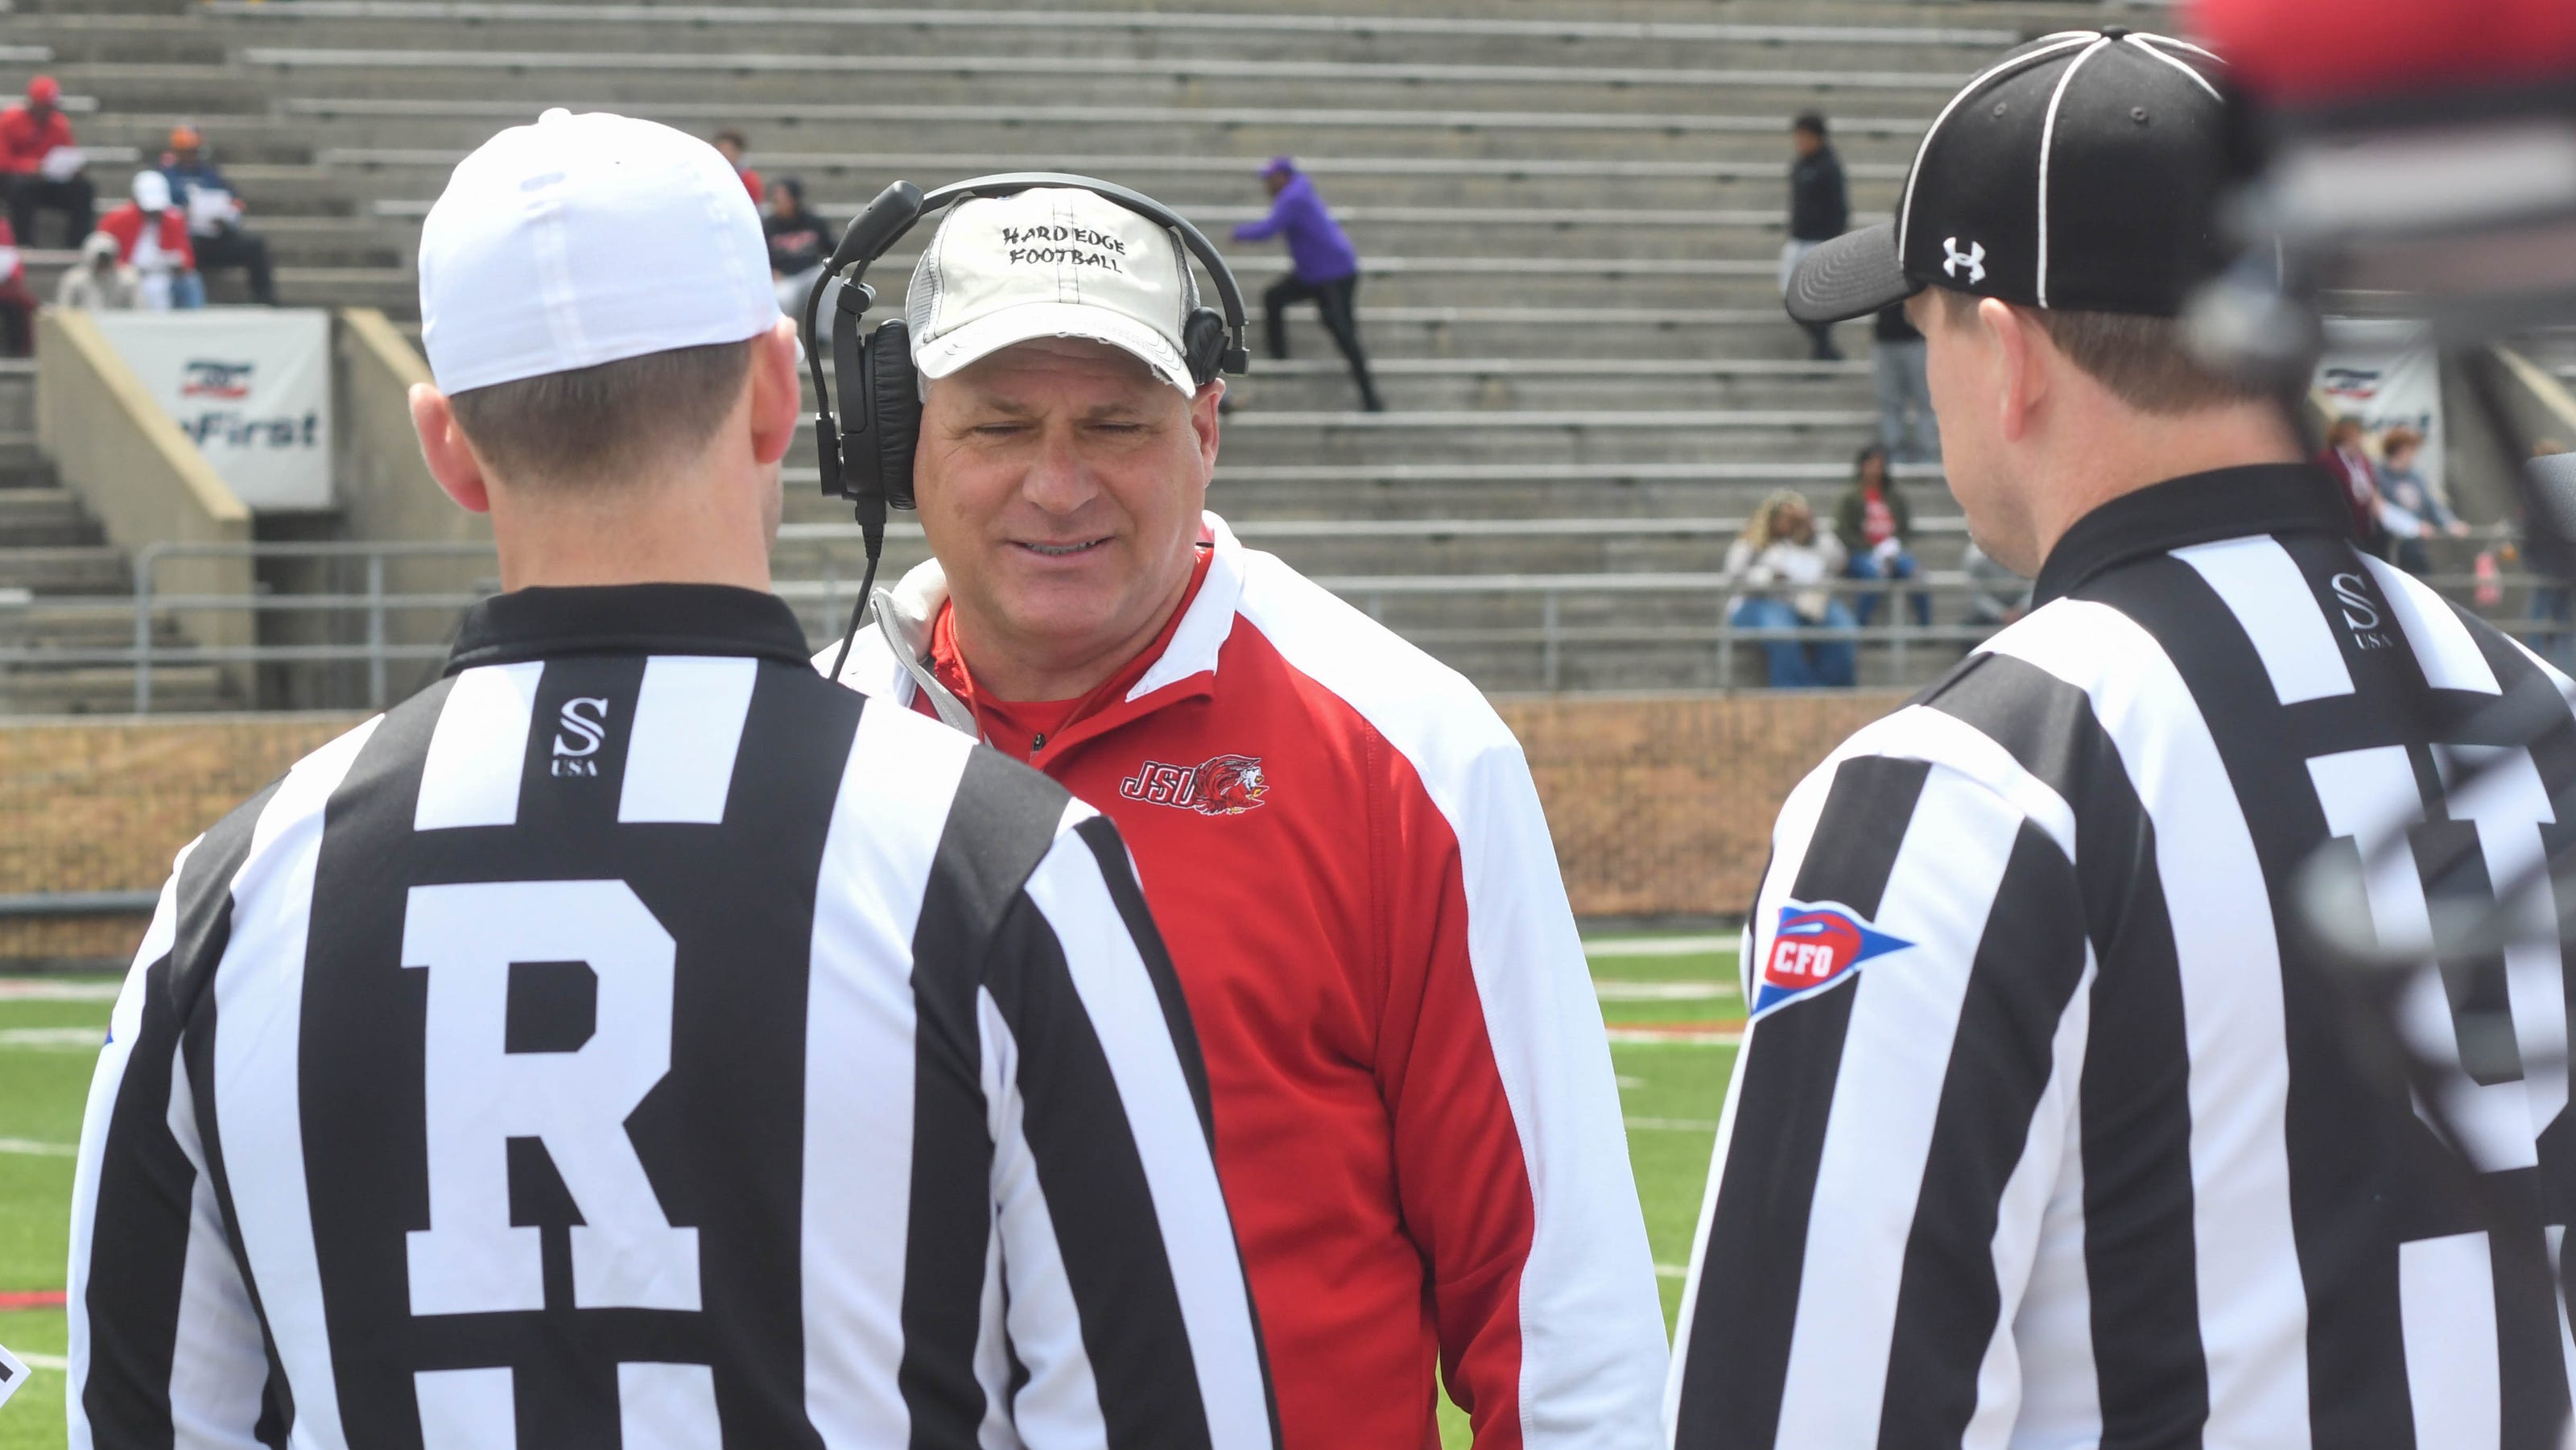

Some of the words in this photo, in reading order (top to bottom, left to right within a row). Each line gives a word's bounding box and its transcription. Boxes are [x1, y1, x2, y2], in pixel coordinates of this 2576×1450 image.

[1002, 225, 1068, 245] HARD
[1073, 228, 1126, 256] EDGE
[1009, 247, 1123, 274] FOOTBALL
[1120, 761, 1199, 808] JSU
[1773, 940, 1835, 978] CFO
[401, 878, 703, 1316] R
